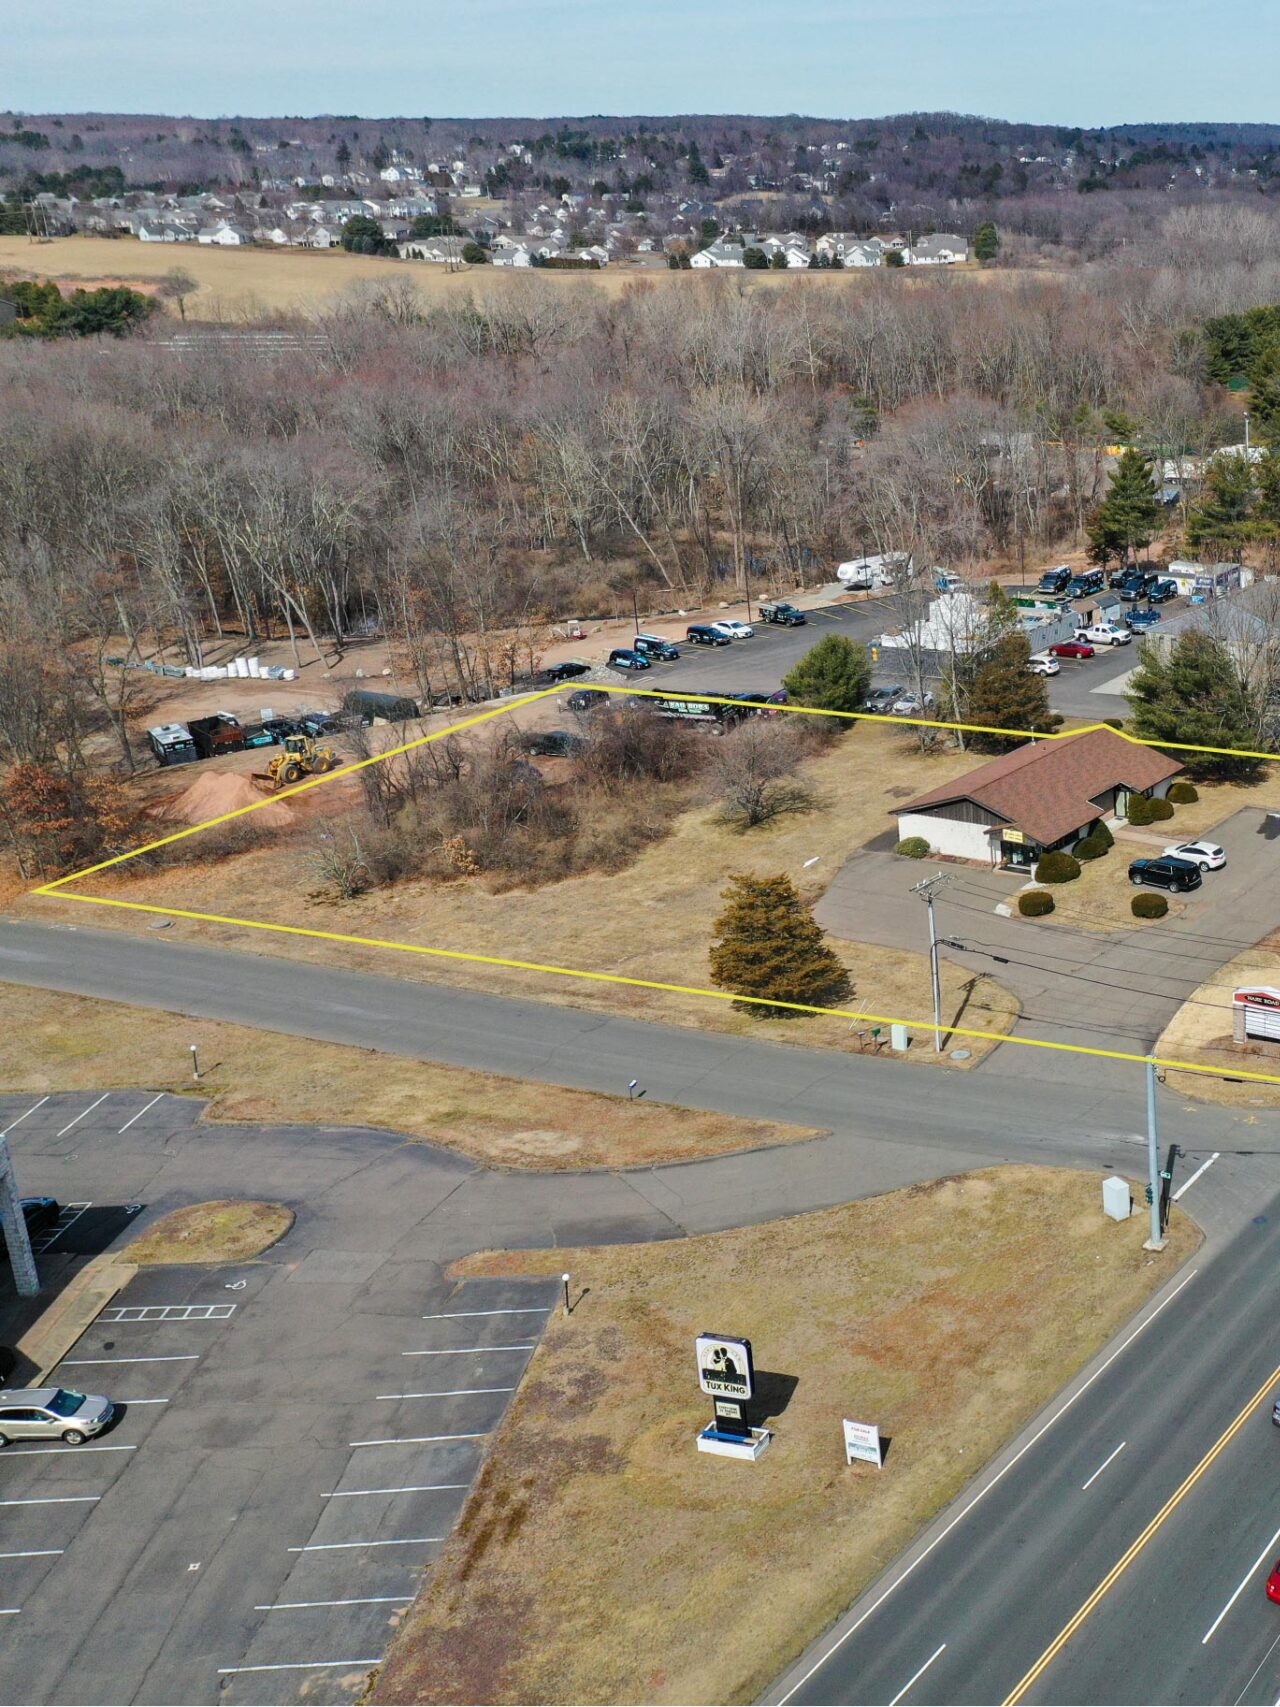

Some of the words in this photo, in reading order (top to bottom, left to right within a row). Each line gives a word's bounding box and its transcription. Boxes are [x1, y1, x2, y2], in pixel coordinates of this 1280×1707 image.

[1263, 998, 1280, 1006] ROAD
[705, 1381, 722, 1391] TUX
[723, 1383, 746, 1394] KING
